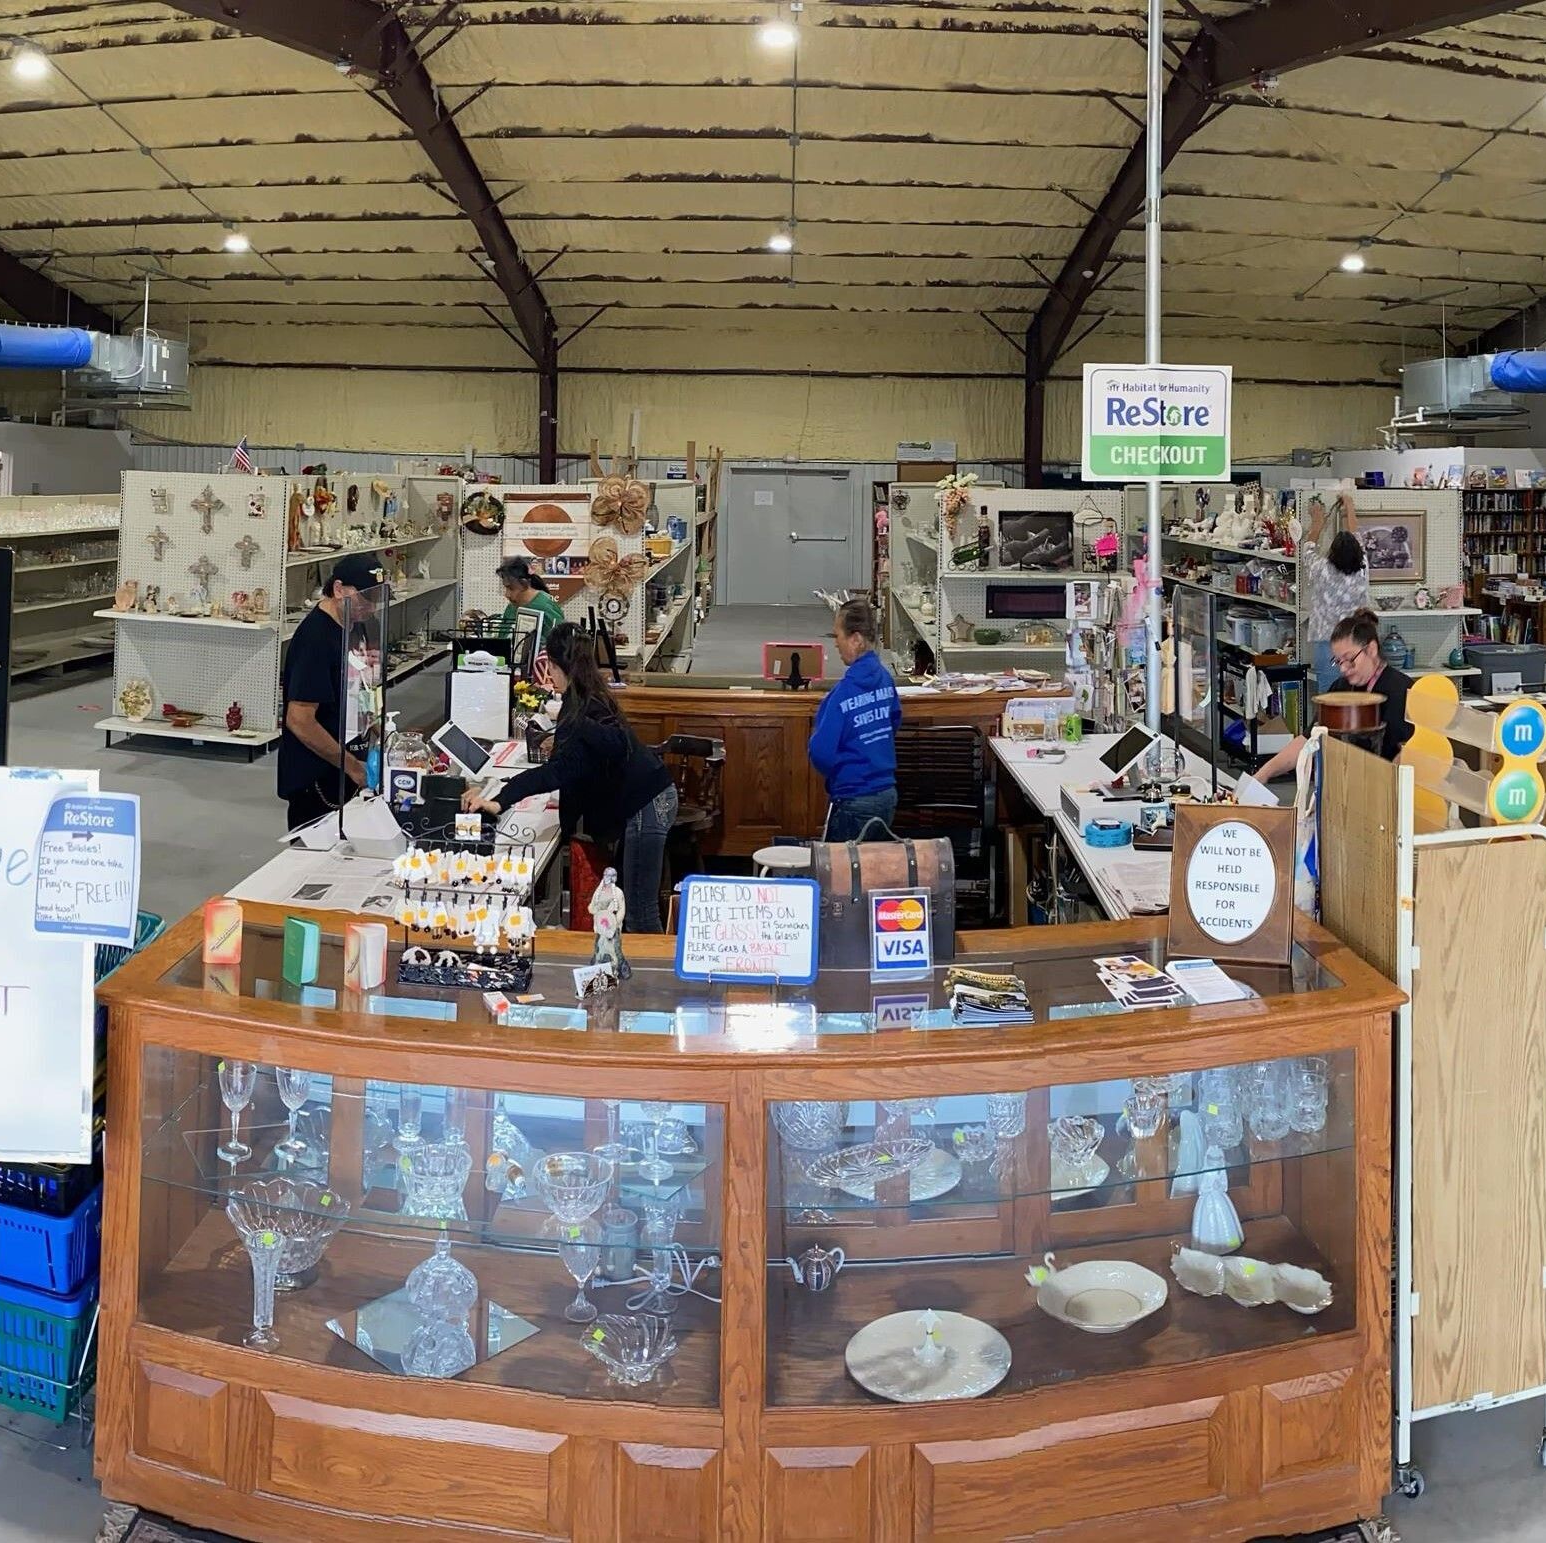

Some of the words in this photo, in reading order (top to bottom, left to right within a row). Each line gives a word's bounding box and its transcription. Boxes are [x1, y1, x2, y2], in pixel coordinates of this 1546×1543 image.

[1122, 383, 1156, 392] Habitat
[1169, 384, 1211, 394] Humanity
[1107, 397, 1209, 426] ReStore
[1111, 446, 1207, 465] CHECKOUT
[840, 691, 875, 714] WEARING
[875, 705, 890, 720] LIV
[1514, 724, 1533, 742] m
[1508, 788, 1527, 805] m
[63, 811, 115, 827] ReStore
[1222, 829, 1238, 839] WE
[43, 841, 64, 853] Free
[67, 842, 101, 854] Bibles!
[1200, 846, 1223, 855] WILL
[1225, 847, 1246, 857] NOT
[1249, 848, 1262, 857] BE
[53, 858, 68, 867] you
[91, 859, 106, 867] one
[1217, 864, 1242, 874] HELD
[38, 877, 72, 893] They're
[75, 880, 131, 905] FREE!!!!
[1195, 880, 1260, 893] RESPONSIBLE
[691, 885, 727, 902] PLEASE
[735, 885, 752, 902] DO
[757, 886, 782, 904] NOT
[1215, 899, 1235, 910] FOR
[690, 906, 721, 923] PLACE
[728, 905, 773, 920] ITEMS
[777, 907, 796, 919] ON
[878, 911, 924, 921] MasterCard
[1198, 916, 1253, 928] ACCIDENTS
[690, 925, 711, 940] THE
[687, 942, 715, 952] PLEASE
[741, 944, 748, 954] A
[749, 942, 789, 956] BASKET
[883, 939, 924, 956] VISA
[686, 954, 705, 962] FROM
[708, 955, 720, 963] THE
